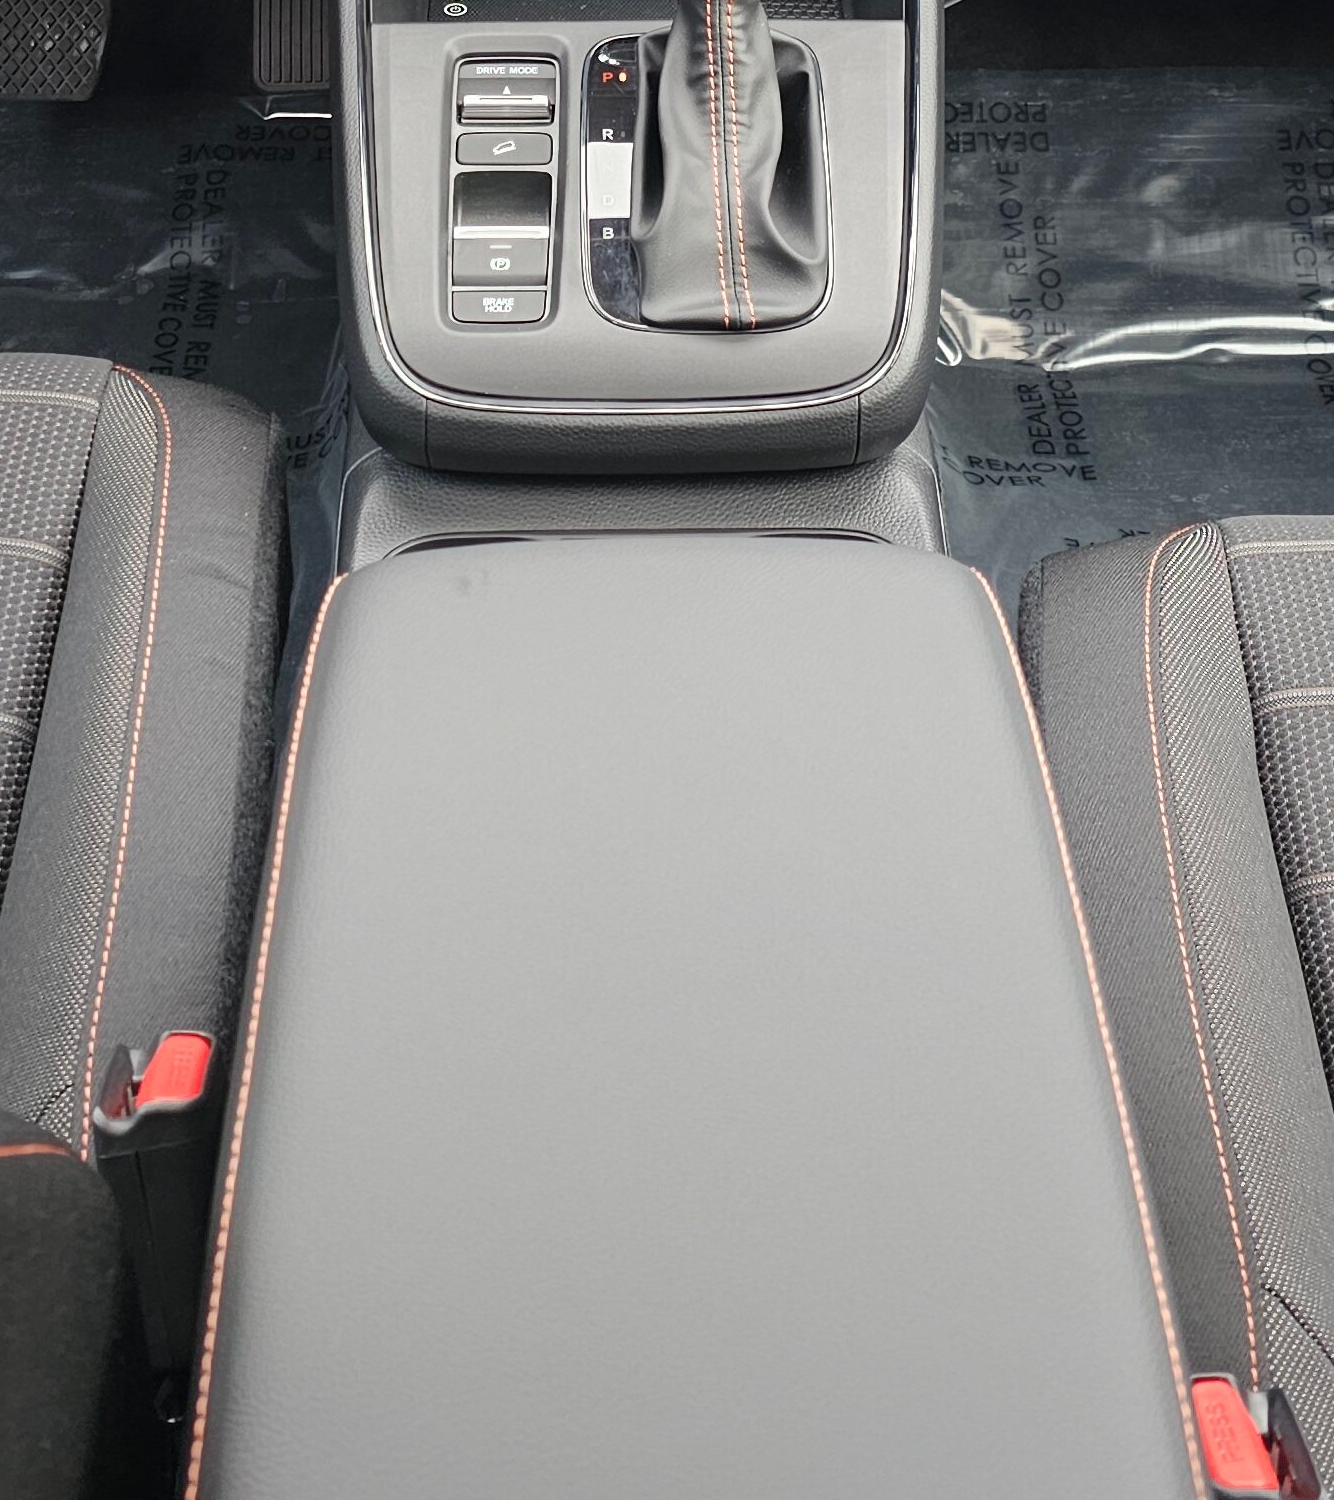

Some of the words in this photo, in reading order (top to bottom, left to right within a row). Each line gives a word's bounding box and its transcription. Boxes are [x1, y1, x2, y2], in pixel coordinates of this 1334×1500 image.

[476, 66, 506, 75] DRIVE
[509, 66, 539, 75] MODE
[602, 72, 613, 83] P
[602, 128, 614, 141] R
[945, 131, 1050, 153] DEALER
[997, 160, 1029, 277] REMOVE
[602, 227, 615, 240] B
[1035, 214, 1068, 311] COVER
[193, 278, 223, 330] MUST
[483, 297, 514, 306] BRAKE
[485, 305, 513, 313] HOLD
[1018, 383, 1056, 456] DEALER
[967, 455, 1098, 481] REMOVE
